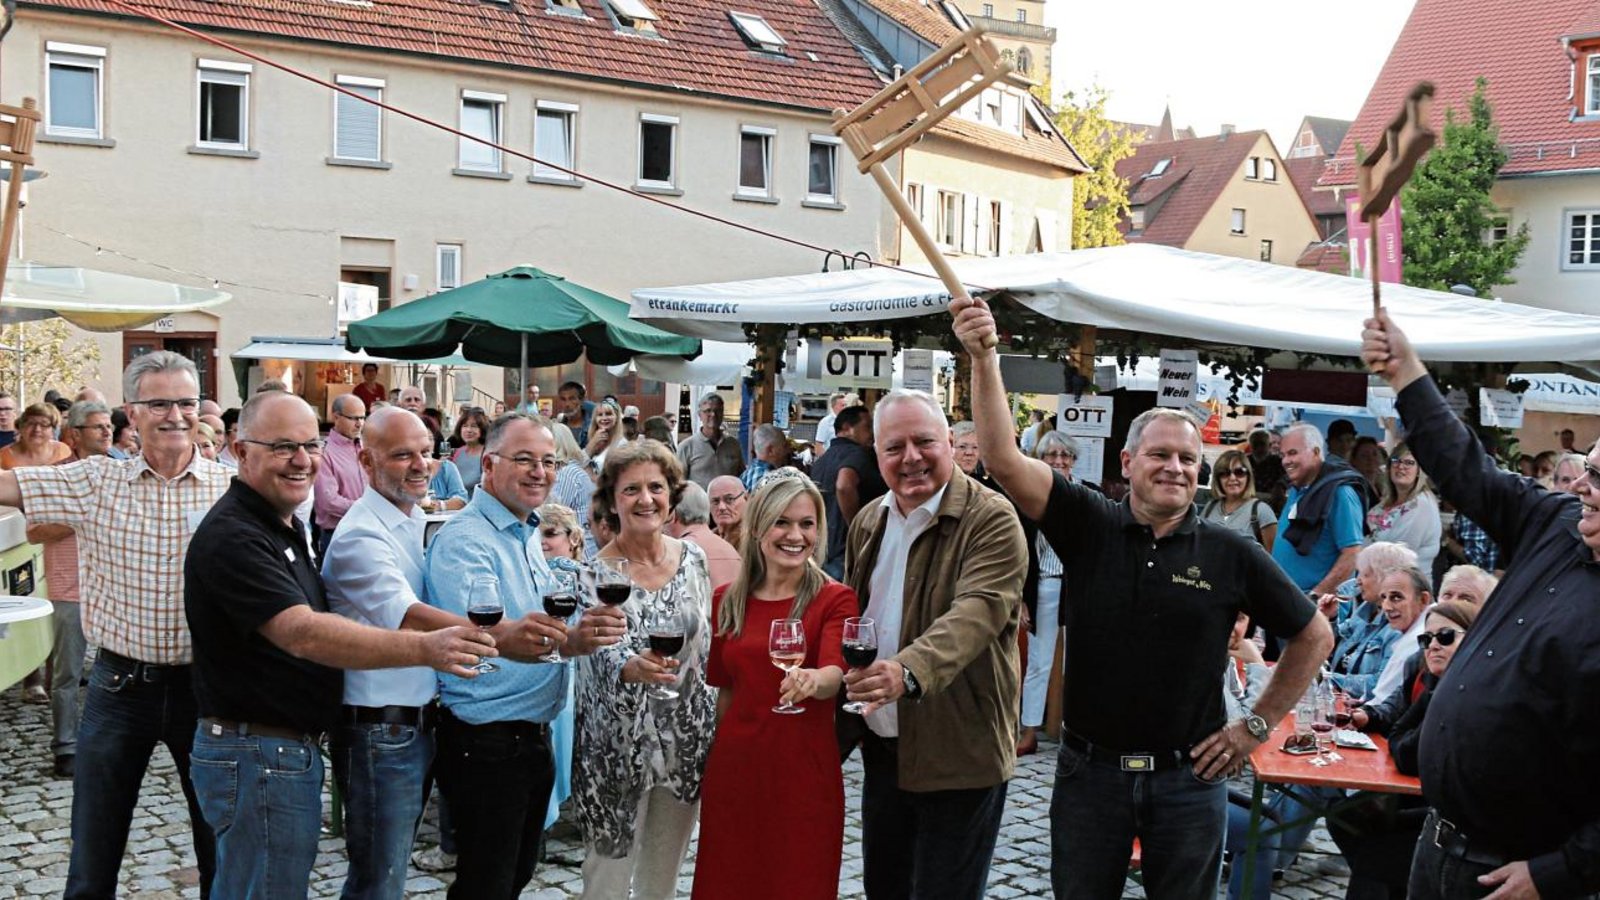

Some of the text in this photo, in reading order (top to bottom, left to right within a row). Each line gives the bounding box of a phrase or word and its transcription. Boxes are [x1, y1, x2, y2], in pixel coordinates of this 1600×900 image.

[922, 294, 933, 307] &
[158, 319, 173, 328] WC
[825, 348, 888, 377] OTT
[1161, 368, 1193, 381] Neuer
[1162, 385, 1190, 398] Wein
[1529, 378, 1600, 397] ONTAN
[1064, 407, 1106, 424] OTT
